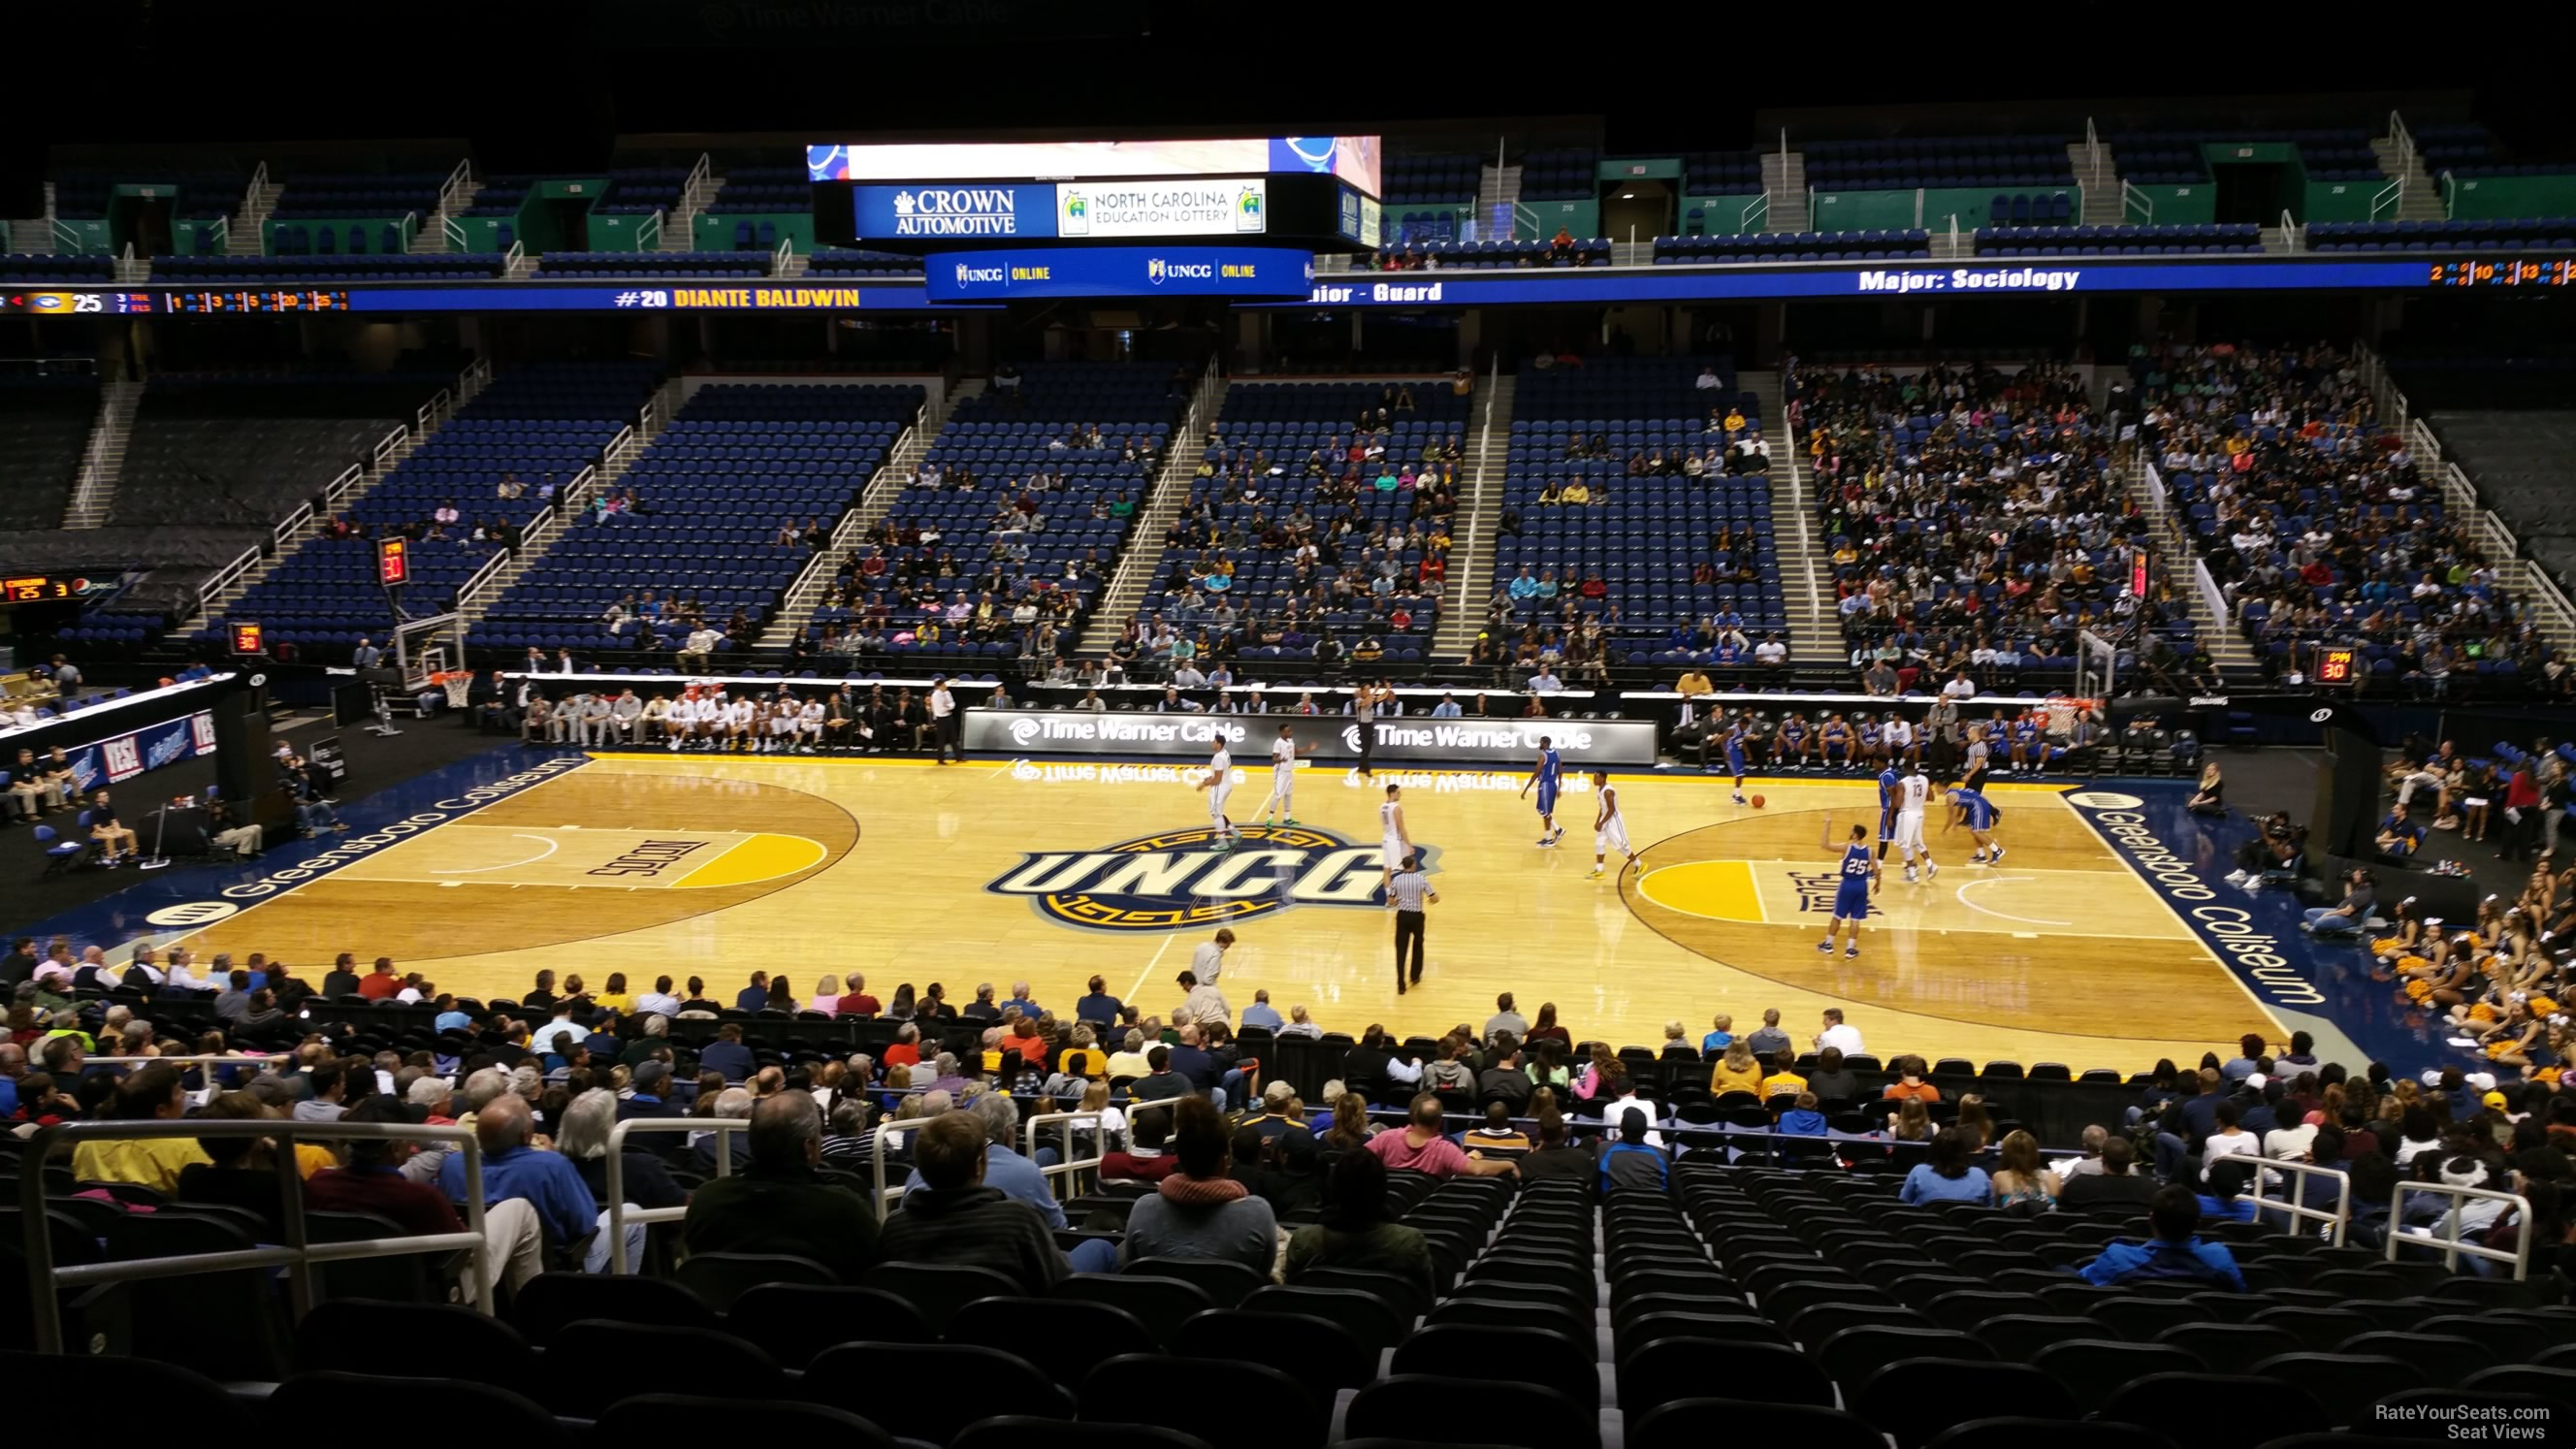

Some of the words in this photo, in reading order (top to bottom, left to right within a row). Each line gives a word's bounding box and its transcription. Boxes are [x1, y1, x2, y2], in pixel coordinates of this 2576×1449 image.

[917, 190, 1014, 213] CROWN
[1096, 193, 1146, 209] NORTH
[1152, 191, 1228, 209] CAROLINA
[1096, 210, 1171, 224] EDUCATION
[1175, 209, 1229, 222] LOTTERY
[895, 216, 1016, 235] AUTOMOTIVE
[968, 268, 1003, 281] UNCG
[1012, 267, 1051, 280] ONLINE
[1167, 265, 1212, 277] UNCG
[1221, 264, 1256, 277] ONLINE
[2431, 266, 2443, 280] 2
[2474, 265, 2494, 279] 10
[2521, 264, 2539, 279] 13
[1859, 271, 1946, 293] Major:
[1951, 268, 2080, 291] Sociology
[116, 294, 126, 303] 3
[614, 291, 667, 307] #20
[674, 289, 751, 307] DIANTE
[756, 289, 860, 307] BALDWIN
[1373, 282, 1442, 302] Guard
[73, 294, 103, 312] 25
[173, 297, 181, 308] 1
[211, 296, 223, 307] 3
[248, 295, 259, 306] 5
[19, 586, 40, 599] 25
[55, 584, 67, 596] 3
[2324, 663, 2344, 679] 30
[1040, 719, 1096, 739] Time
[1097, 720, 1179, 741] Warner
[1374, 724, 1433, 747] Time
[1434, 725, 1522, 748] Warner
[1523, 729, 1593, 750] Cble
[1551, 762, 1556, 776] 1
[1913, 784, 1922, 797] 13
[221, 811, 447, 898] Greensboro
[434, 757, 580, 811] Coliseum
[586, 840, 711, 877] SOCON
[1846, 858, 1869, 875] 25
[999, 849, 1385, 900] UNCG
[2096, 811, 2217, 900] Greensboro
[2192, 906, 2327, 1005] Coliseum
